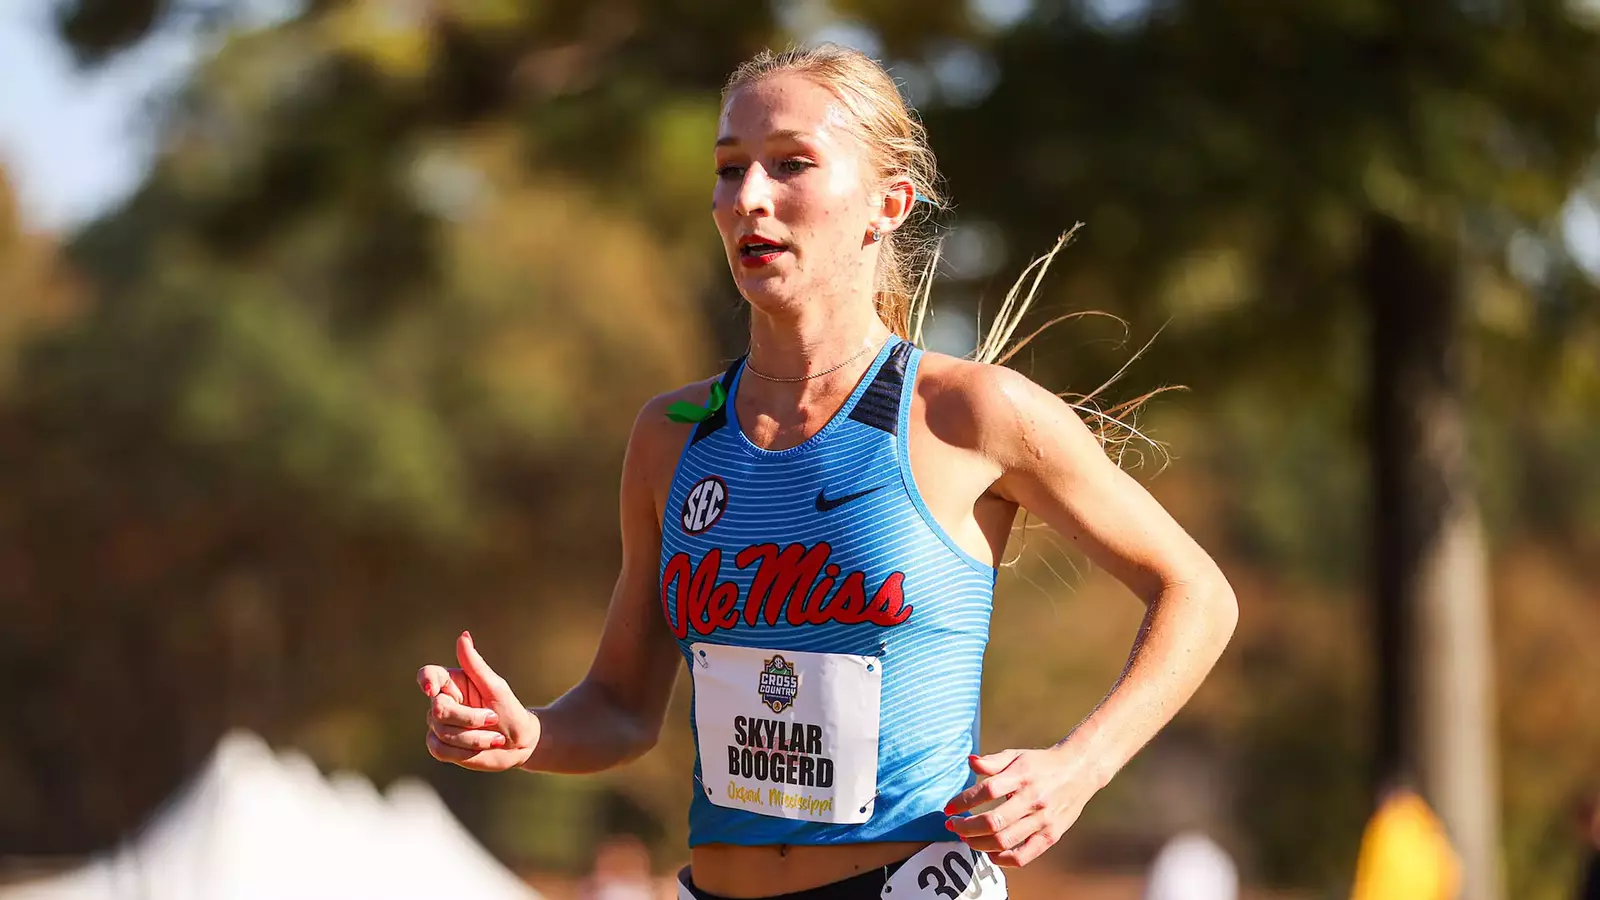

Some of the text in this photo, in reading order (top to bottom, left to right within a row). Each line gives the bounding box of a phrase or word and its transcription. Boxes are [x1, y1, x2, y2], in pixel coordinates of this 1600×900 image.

[683, 480, 724, 531] SEC
[662, 541, 913, 640] Ole Miss
[759, 685, 796, 697] COUNTRY
[761, 673, 797, 688] CROSS
[734, 715, 822, 755] SKYLAR
[728, 745, 834, 788] BOOGERD
[768, 787, 834, 816] Mississippi
